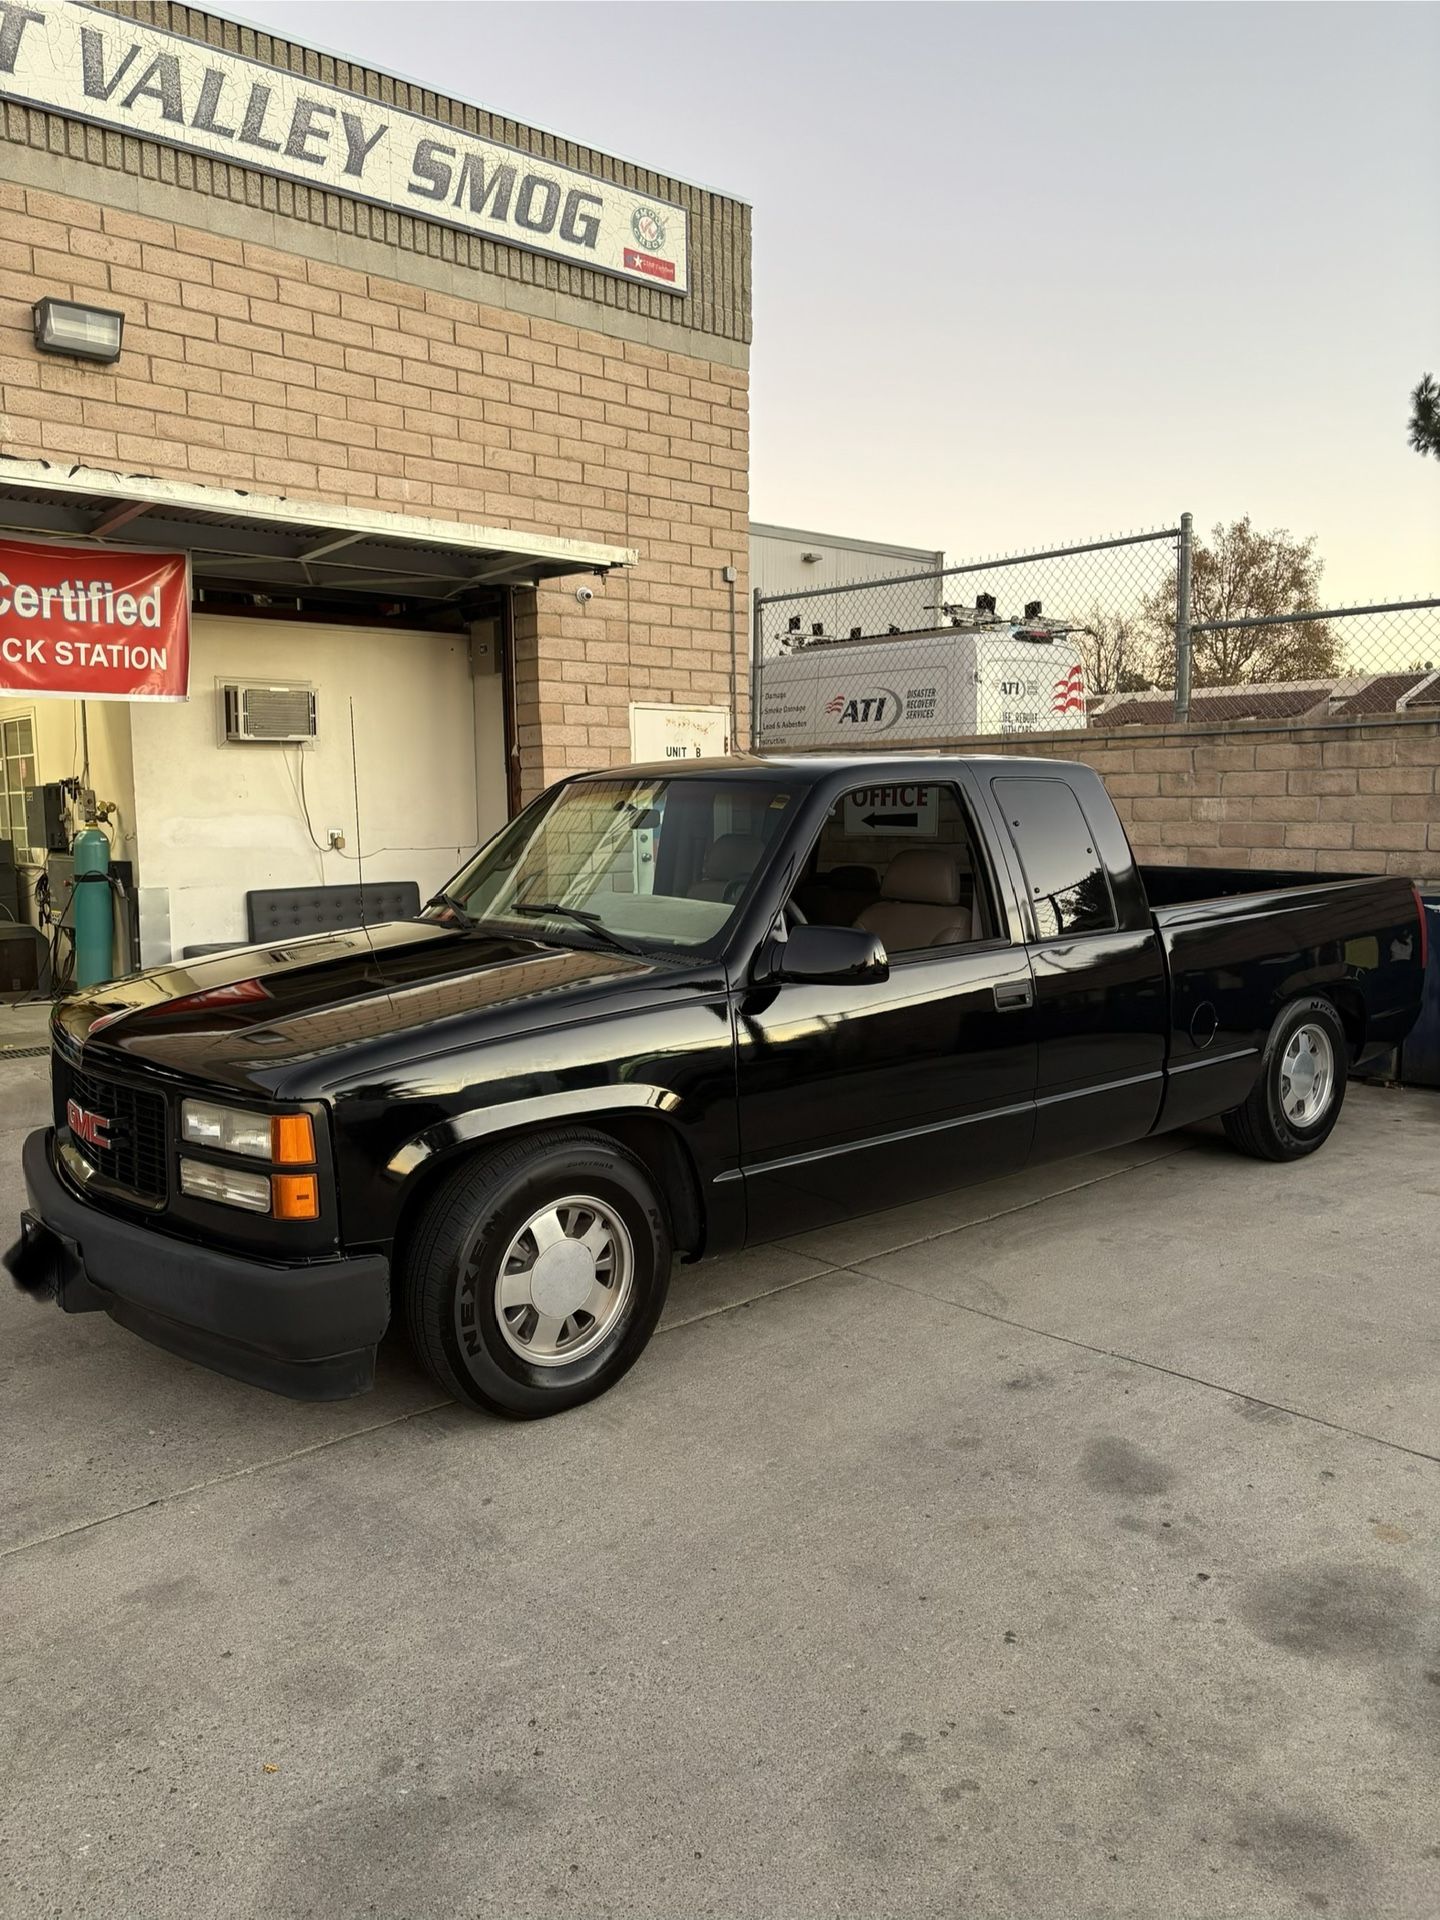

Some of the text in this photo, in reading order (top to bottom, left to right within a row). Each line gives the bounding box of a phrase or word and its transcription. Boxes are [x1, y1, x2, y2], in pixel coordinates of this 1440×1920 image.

[81, 26, 389, 177] VALLEY
[407, 139, 603, 249] SMOG
[0, 571, 161, 627] Certified
[0, 638, 168, 670] CK STATION
[907, 688, 937, 699] DISASTER
[1000, 682, 1020, 695] ATI
[838, 697, 887, 724] ATI
[905, 709, 934, 720] SERVICES
[906, 698, 937, 709] RECOVERY
[666, 747, 701, 758] UNIT B
[851, 785, 928, 807] OFFICE
[67, 1098, 111, 1149] GMC
[460, 1208, 504, 1358] NEXEN
